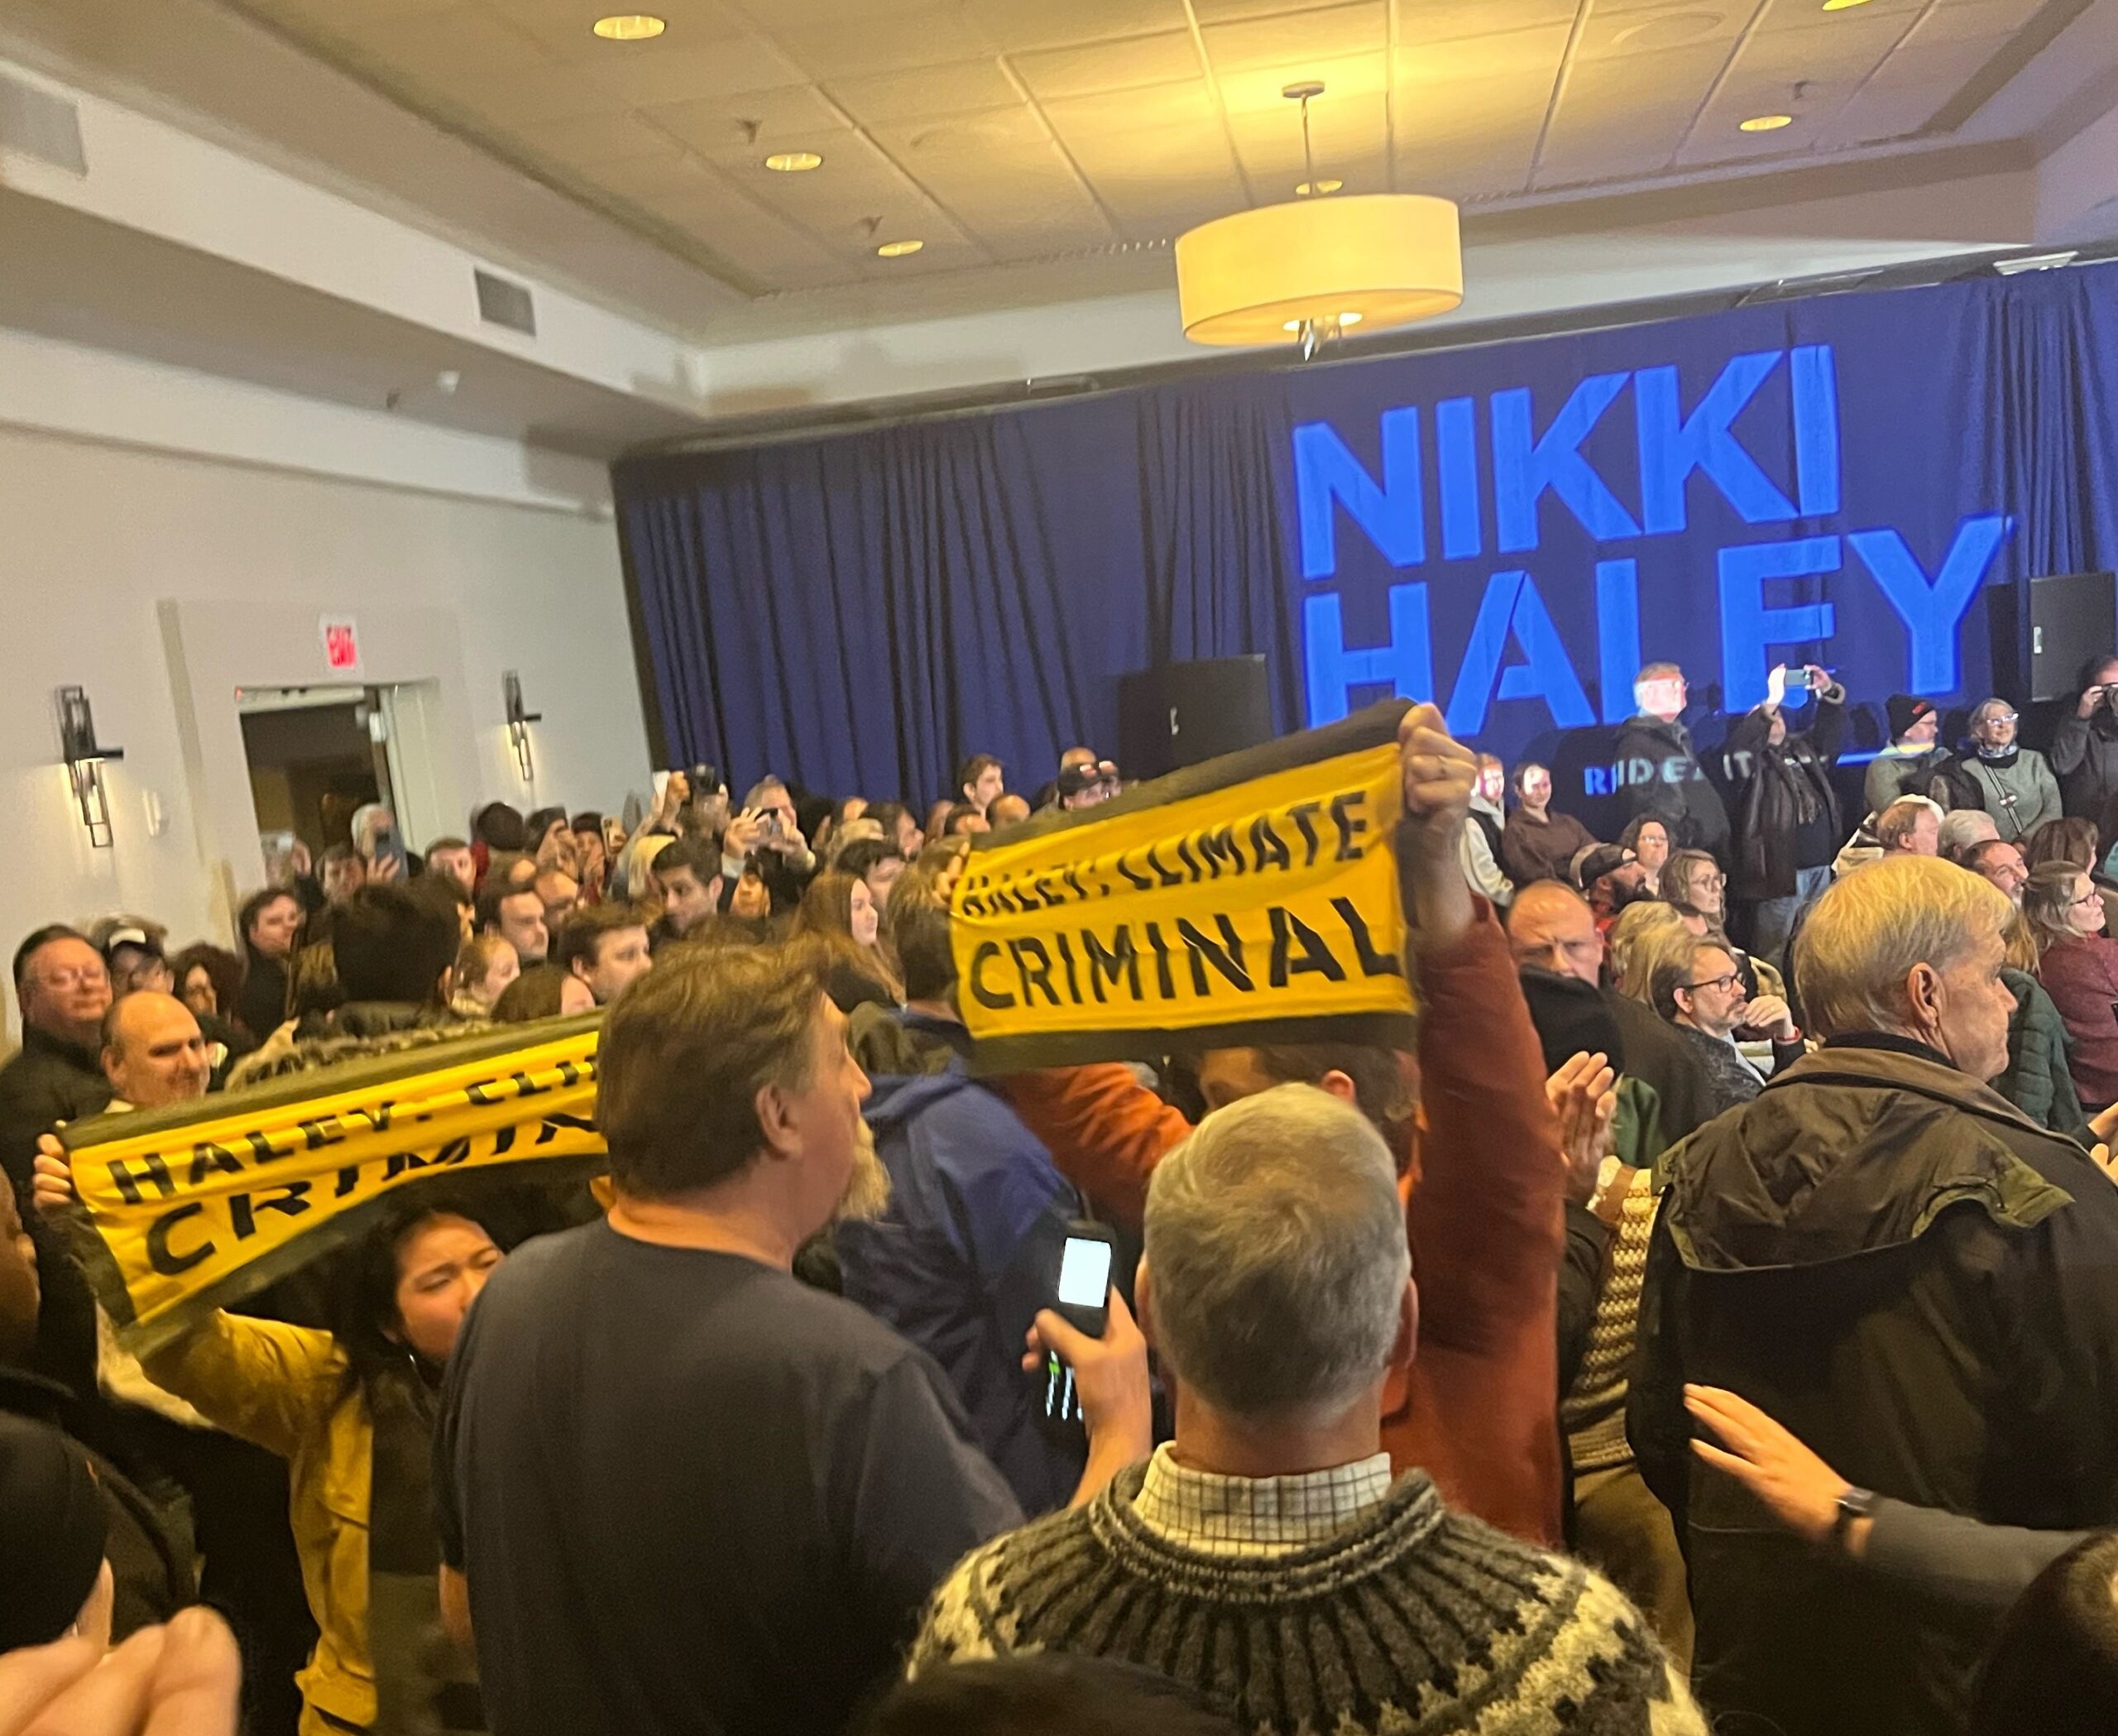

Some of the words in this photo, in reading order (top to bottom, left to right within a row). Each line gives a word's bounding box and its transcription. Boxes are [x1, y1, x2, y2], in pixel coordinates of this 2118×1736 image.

[1293, 344, 1840, 580] NIKKI
[1303, 515, 2014, 738] HALEY
[1117, 790, 1367, 891] CLIMATE
[969, 895, 1405, 1009] CRIMINAL
